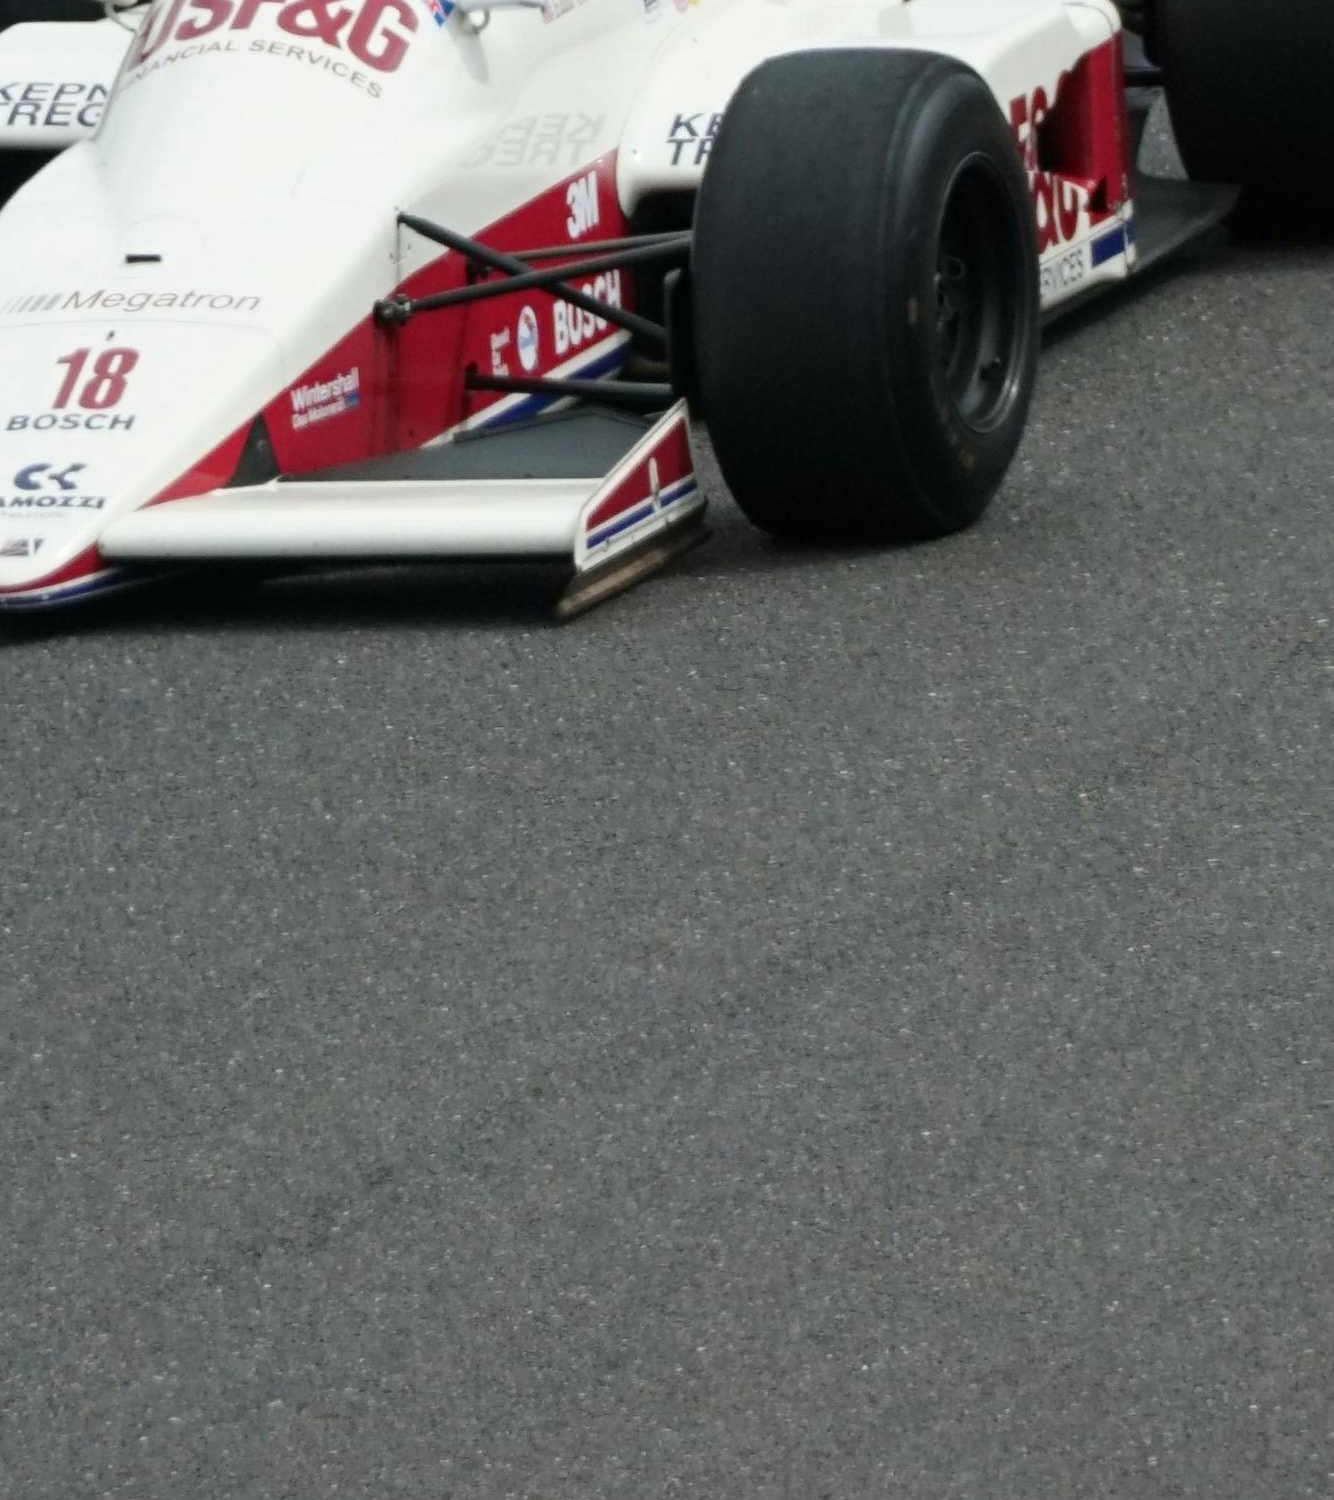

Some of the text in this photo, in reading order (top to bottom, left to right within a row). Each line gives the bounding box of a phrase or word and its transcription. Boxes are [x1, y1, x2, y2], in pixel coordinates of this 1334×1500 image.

[248, 39, 382, 99] SERVICES
[567, 170, 599, 239] 3M
[61, 289, 261, 313] Megatron
[51, 347, 140, 409] 18
[5, 413, 137, 431] BOSCH
